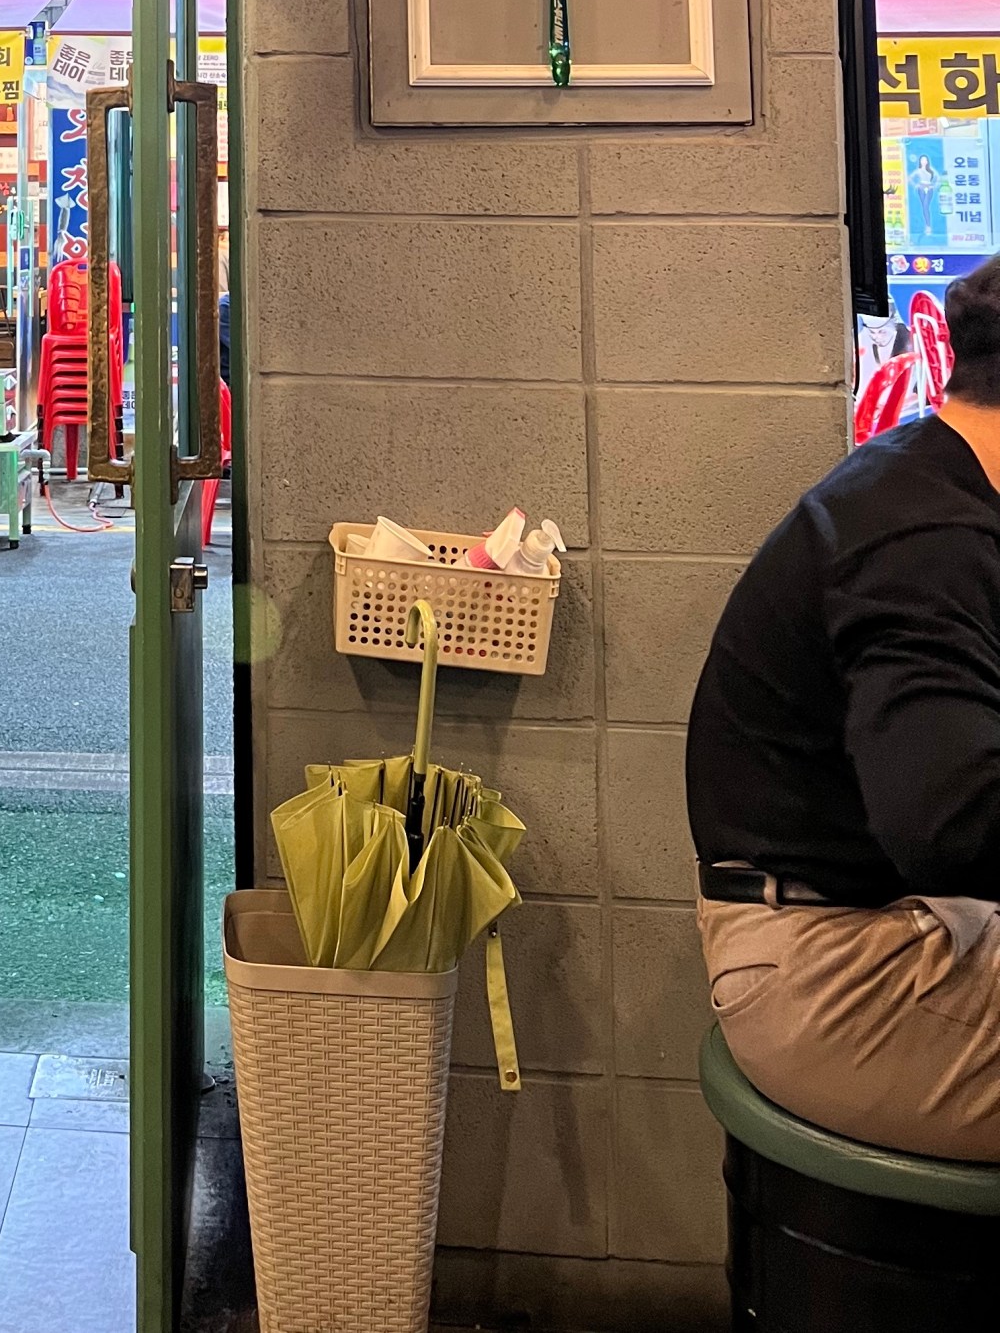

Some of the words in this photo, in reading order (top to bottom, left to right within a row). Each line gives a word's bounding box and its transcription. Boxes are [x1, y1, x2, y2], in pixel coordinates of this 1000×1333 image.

[59, 43, 92, 68] 좋은
[52, 58, 86, 83] 데이
[109, 67, 129, 82] 데
[953, 157, 979, 168] 오늘
[954, 174, 980, 186] 운동
[955, 192, 981, 205] 완료
[955, 211, 982, 223] 기념
